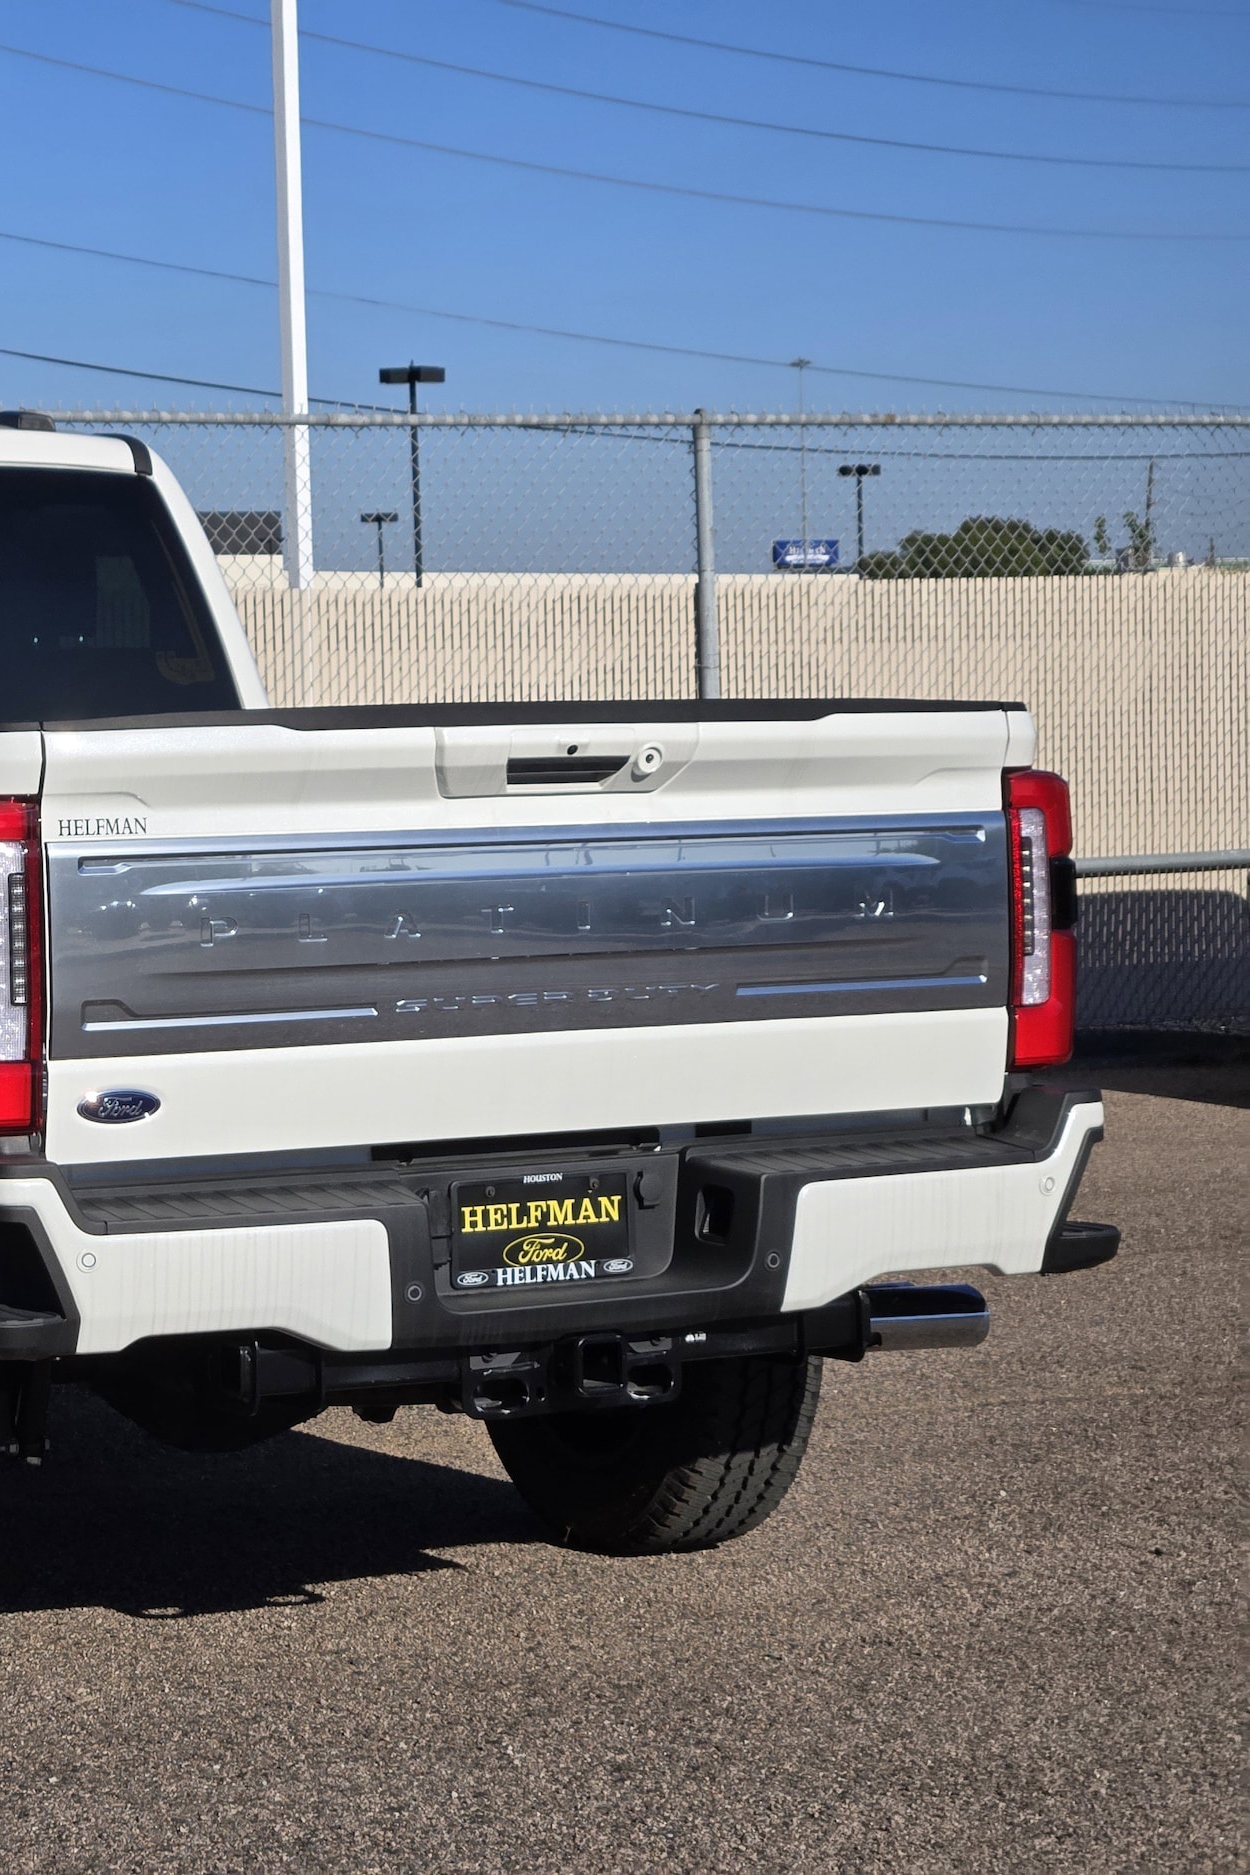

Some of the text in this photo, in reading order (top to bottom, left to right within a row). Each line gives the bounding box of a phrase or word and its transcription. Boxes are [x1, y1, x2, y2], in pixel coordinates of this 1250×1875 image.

[58, 817, 147, 836] HELFMAN
[200, 889, 895, 948] PLATINUM
[97, 1097, 143, 1118] Ford
[523, 1173, 563, 1184] HOUSTON
[461, 1195, 622, 1233] HELFMAN
[518, 1238, 568, 1263] Ford
[496, 1260, 596, 1286] HELFMAN
